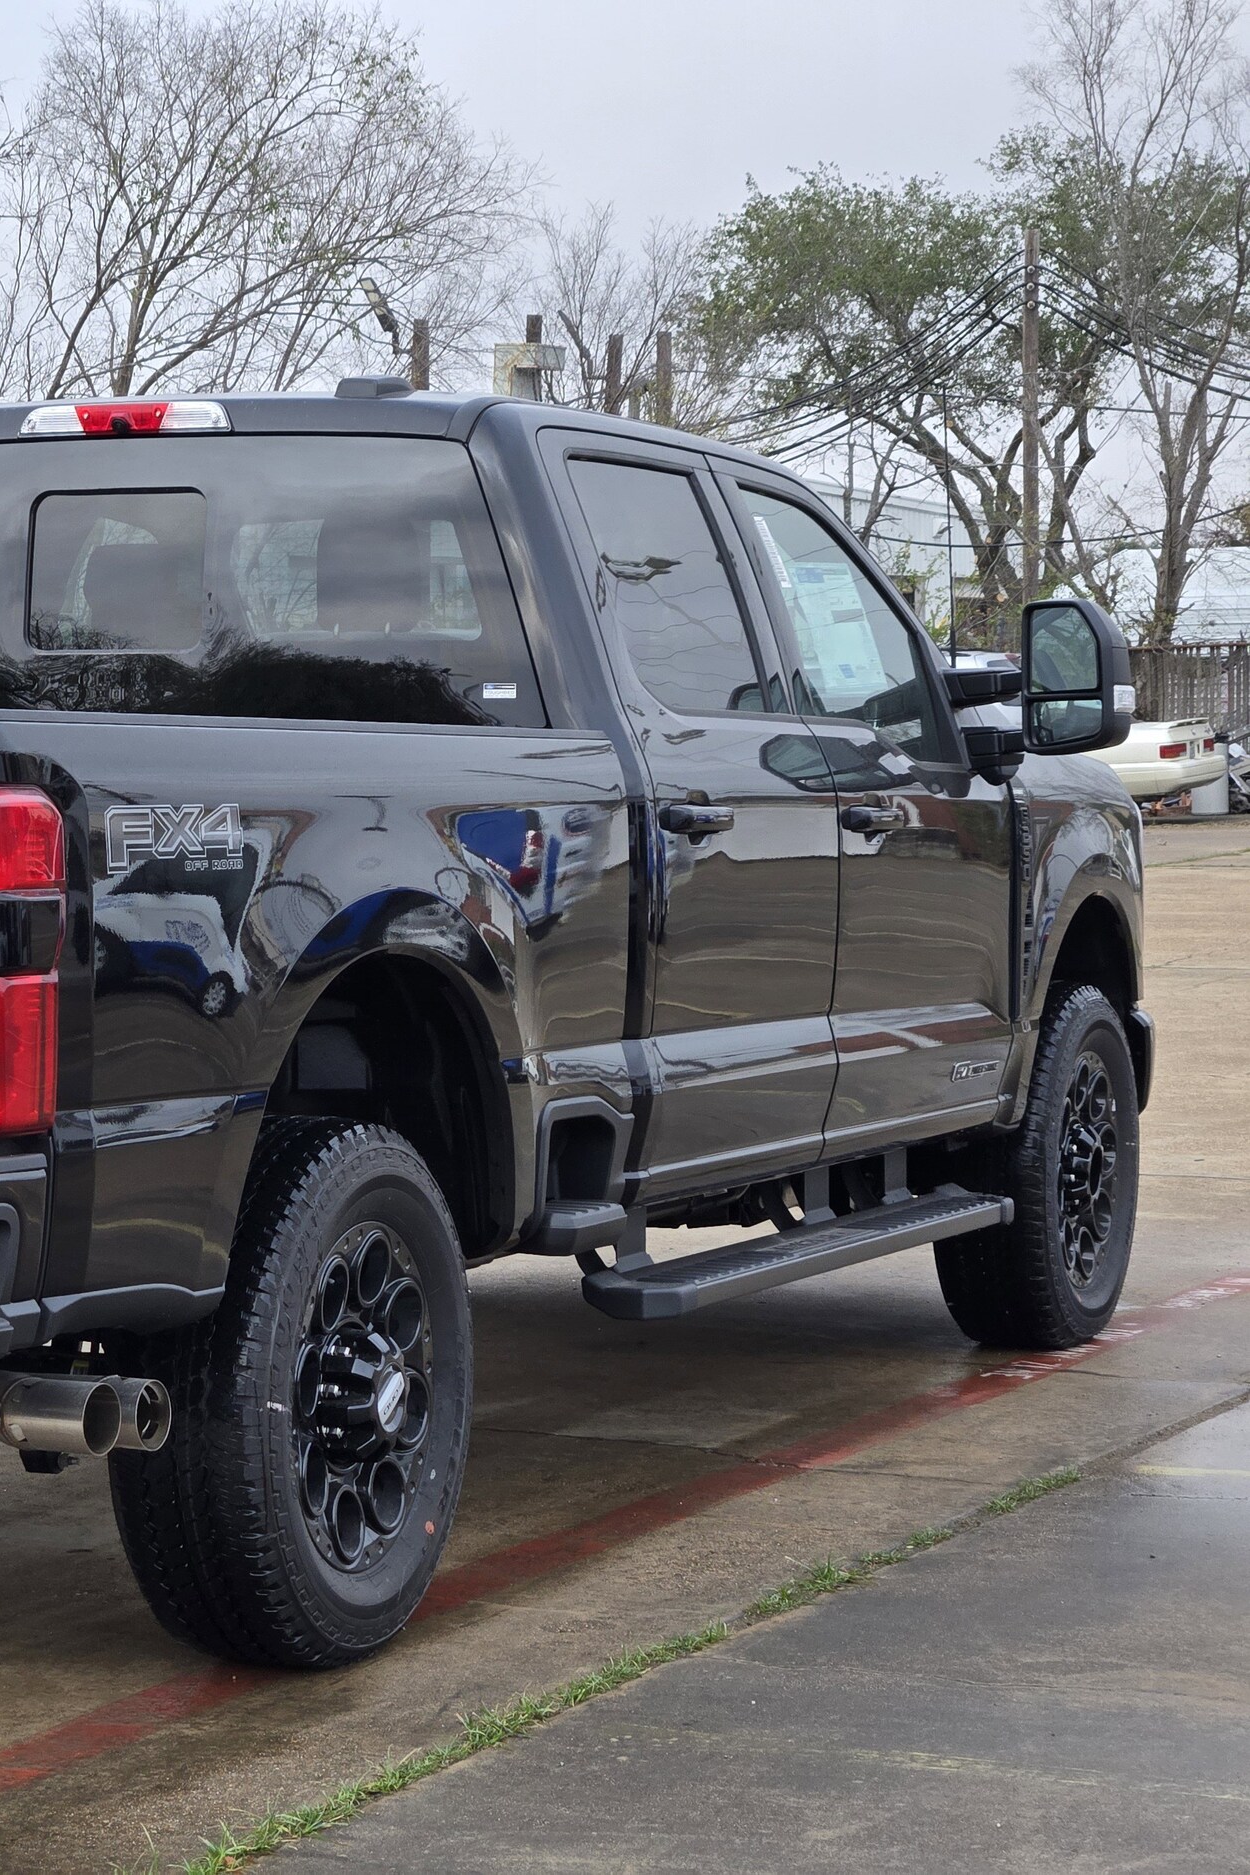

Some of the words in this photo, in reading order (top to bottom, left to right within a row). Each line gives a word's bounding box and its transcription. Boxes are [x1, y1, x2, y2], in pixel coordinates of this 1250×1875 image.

[104, 803, 244, 874] FX4
[185, 860, 209, 871] OFF
[212, 859, 243, 870] ROAD
